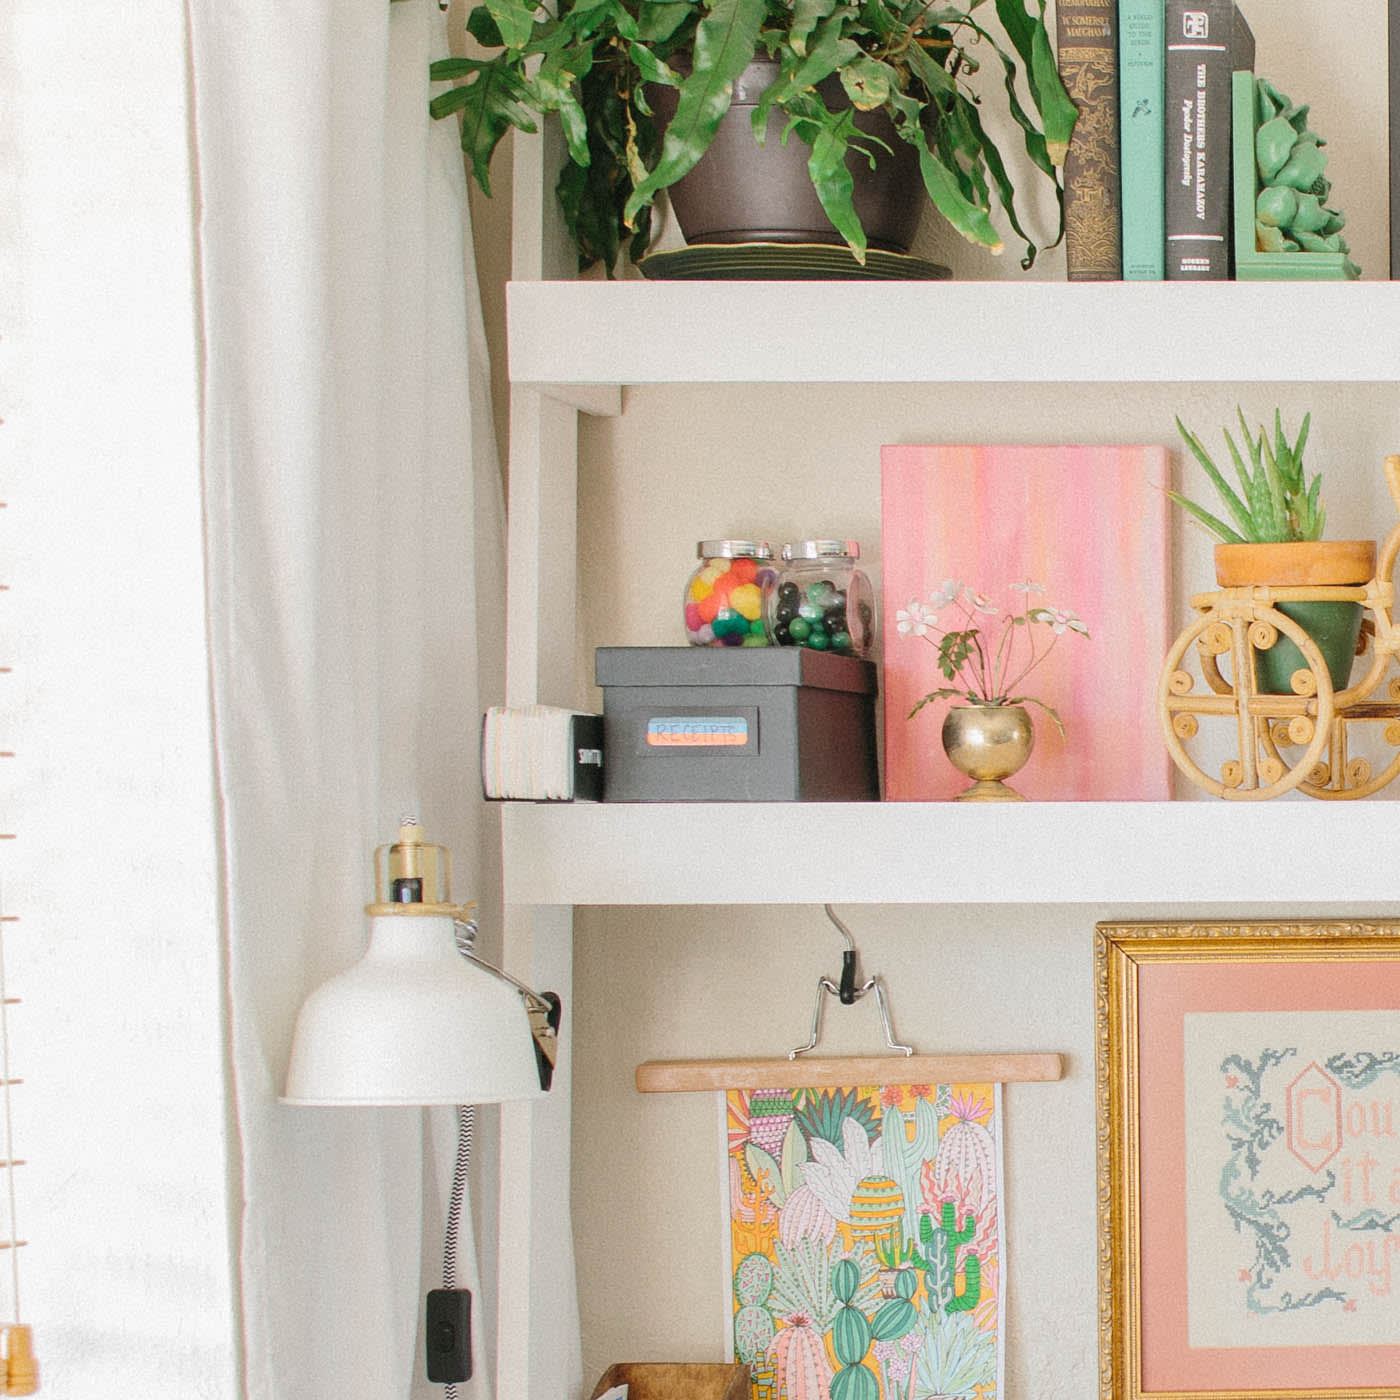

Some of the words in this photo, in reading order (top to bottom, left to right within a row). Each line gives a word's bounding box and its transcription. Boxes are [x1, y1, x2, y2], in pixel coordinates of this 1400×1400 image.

[1196, 63, 1207, 88] THE
[1182, 99, 1193, 133] Fyodor
[1196, 90, 1206, 149] BROTHERS
[1195, 151, 1206, 220] KARAMAZOV
[655, 723, 737, 743] RECEIPTS
[1341, 1152, 1380, 1204] it
